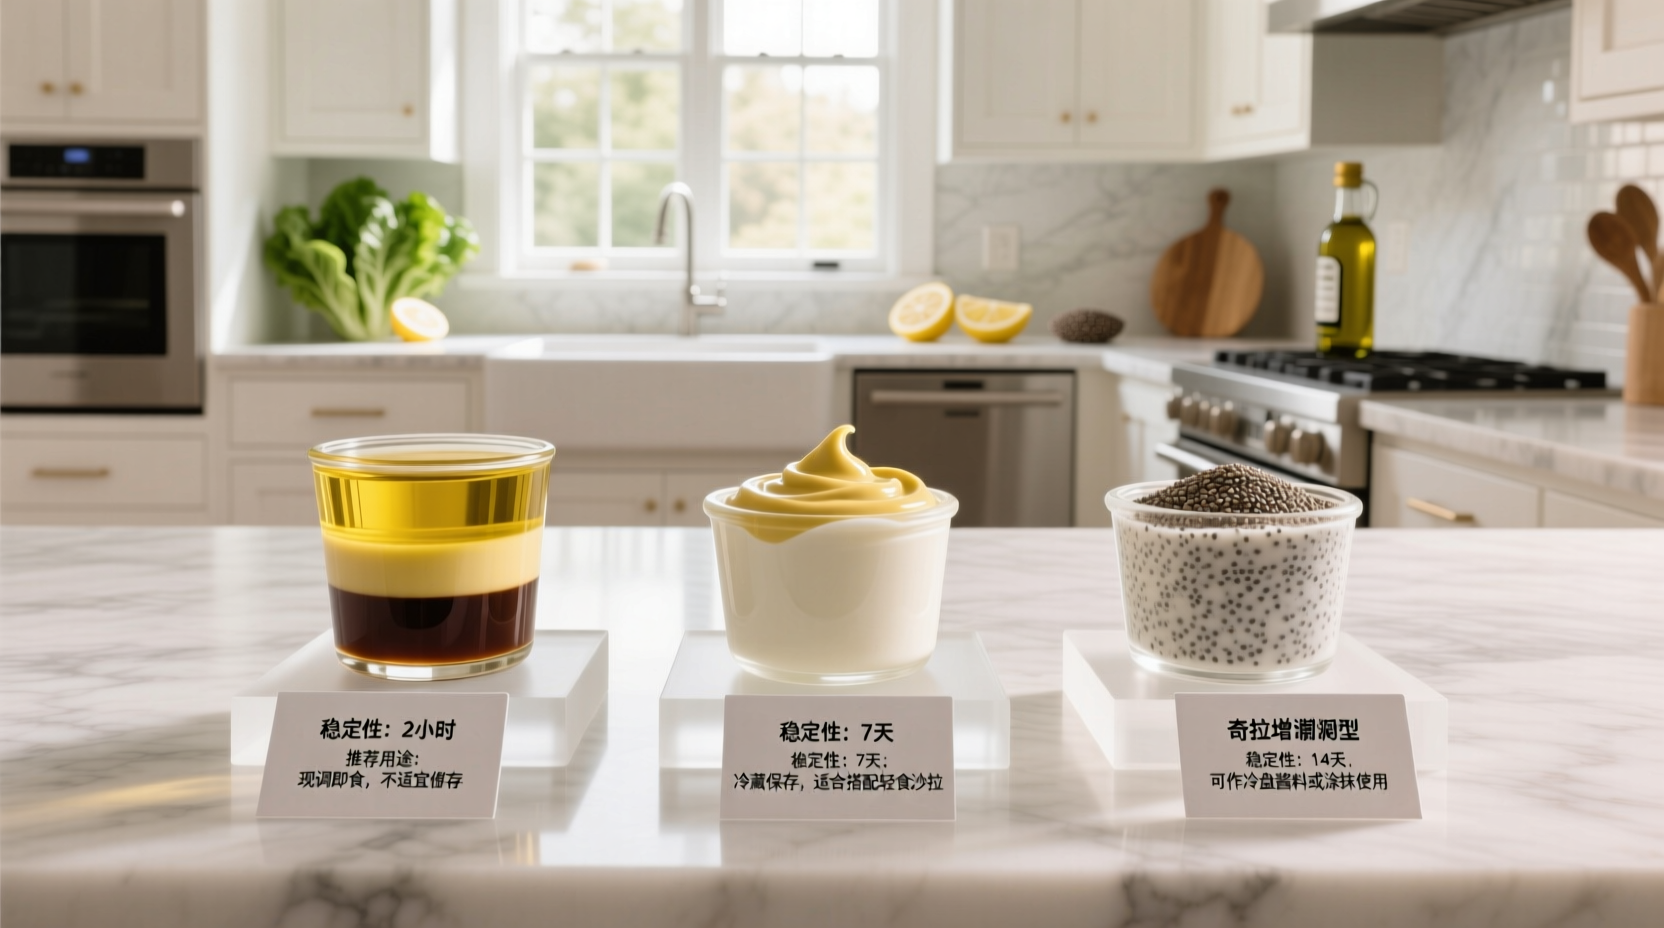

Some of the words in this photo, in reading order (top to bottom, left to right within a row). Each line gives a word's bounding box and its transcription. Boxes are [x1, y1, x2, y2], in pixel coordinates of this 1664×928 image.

[319, 717, 457, 741] 稳定性：2小时
[779, 720, 894, 743] 稳定性：7天
